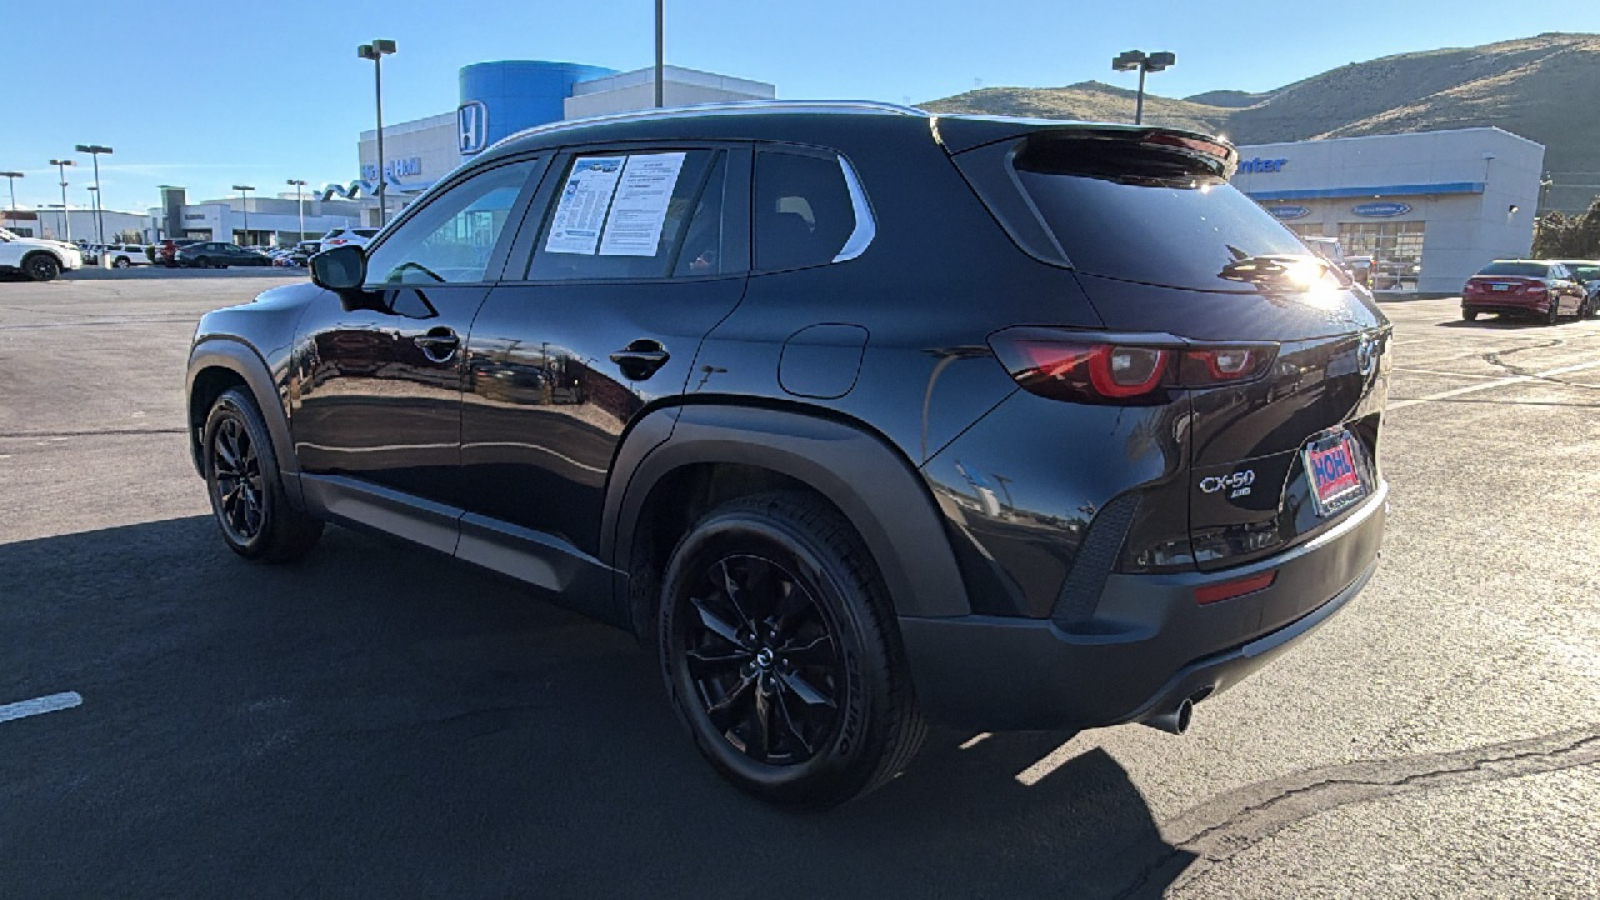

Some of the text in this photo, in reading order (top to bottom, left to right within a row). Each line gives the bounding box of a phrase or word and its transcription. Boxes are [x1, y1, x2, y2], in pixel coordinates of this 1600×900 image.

[1238, 157, 1287, 174] nter
[1313, 451, 1350, 485] HOHL
[1200, 470, 1255, 493] CX-50
